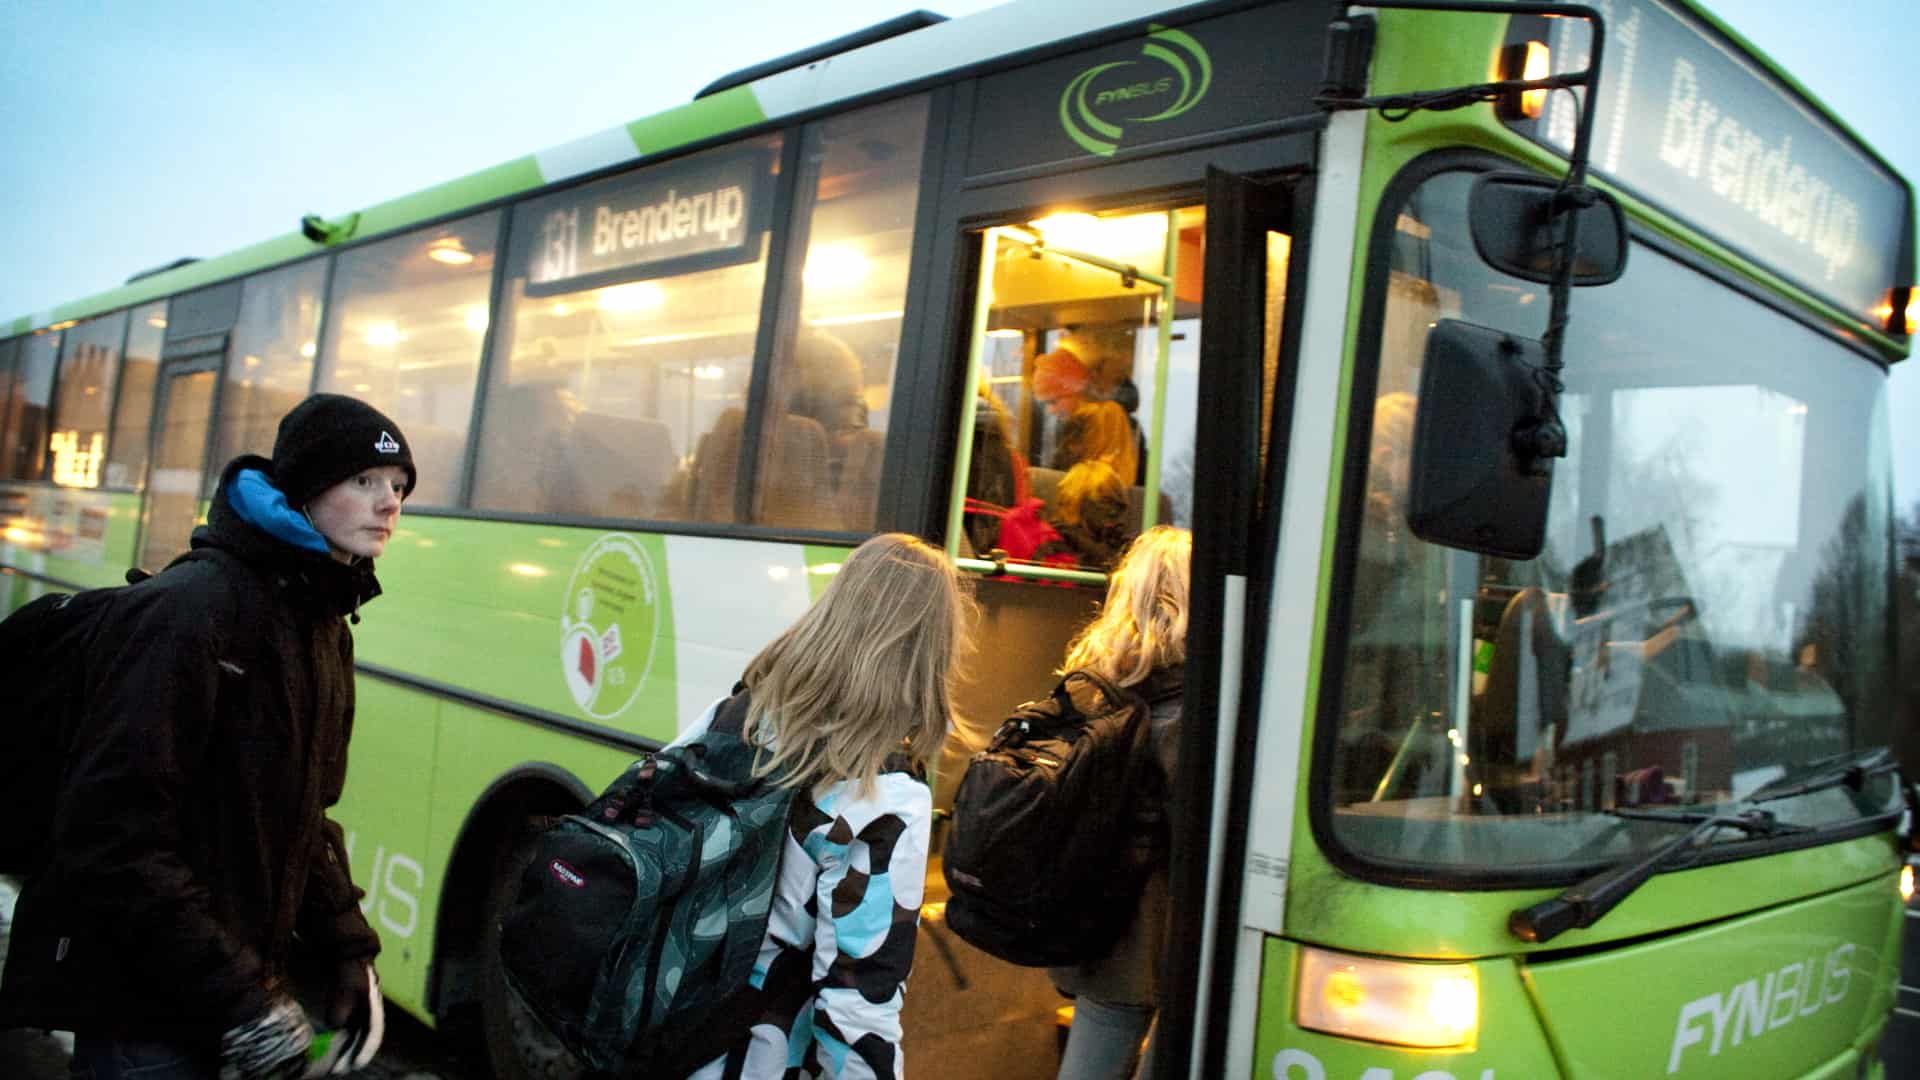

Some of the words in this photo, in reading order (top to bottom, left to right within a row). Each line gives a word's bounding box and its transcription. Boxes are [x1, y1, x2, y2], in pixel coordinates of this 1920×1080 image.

[542, 207, 578, 282] 131
[593, 184, 744, 256] Brenderup
[1659, 57, 1858, 281] Brenderup
[1667, 943, 1856, 1074] FYNBUS
